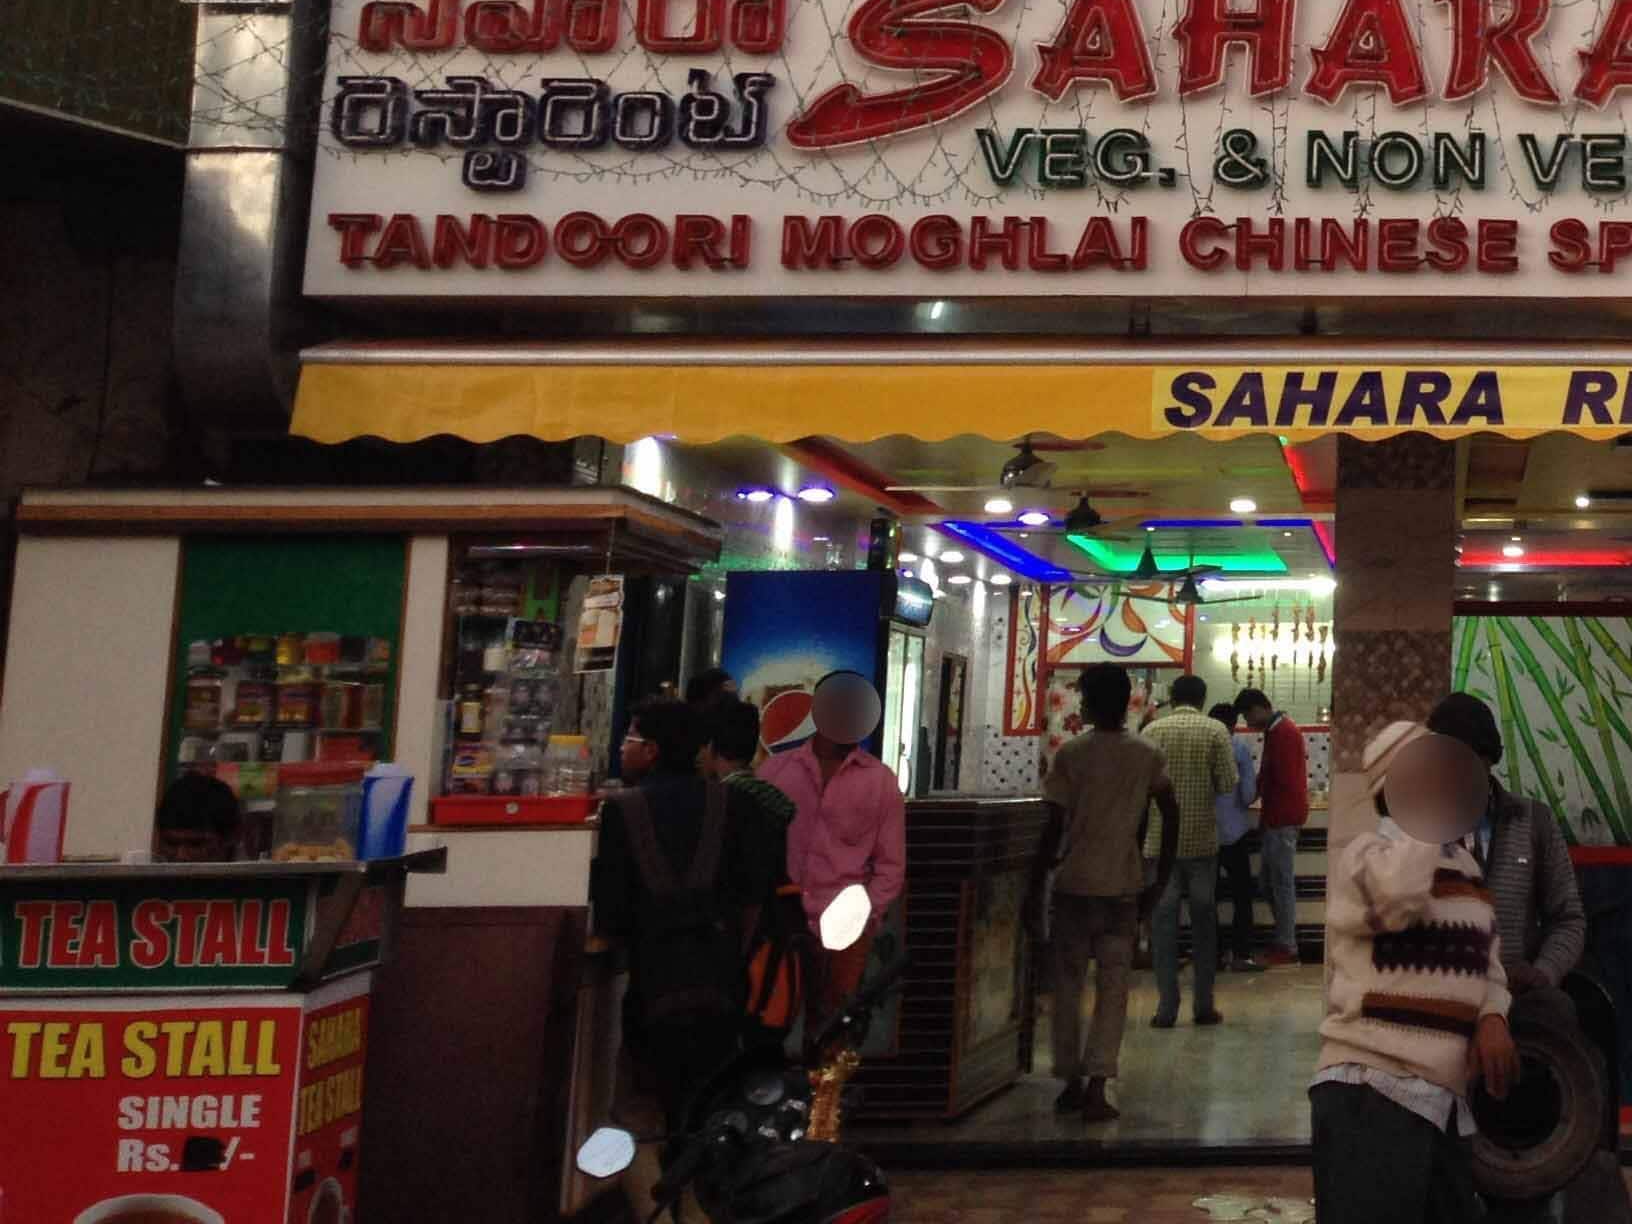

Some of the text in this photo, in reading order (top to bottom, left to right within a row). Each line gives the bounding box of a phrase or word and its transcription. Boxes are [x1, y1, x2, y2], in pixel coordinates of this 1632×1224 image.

[975, 127, 1177, 189] VEG.
[1213, 128, 1274, 189] &
[1305, 130, 1485, 190] NON
[328, 212, 751, 270] TANDOORI
[780, 214, 1150, 272] MOGHLAI
[1179, 216, 1520, 274] CHINESE
[1163, 369, 1505, 429] SAHARA
[14, 898, 120, 969] TEA
[130, 898, 296, 969] STALL
[7, 1020, 281, 1078] TEA STALL
[117, 1094, 263, 1130] SINGLE
[116, 1136, 256, 1173] Rs./-
